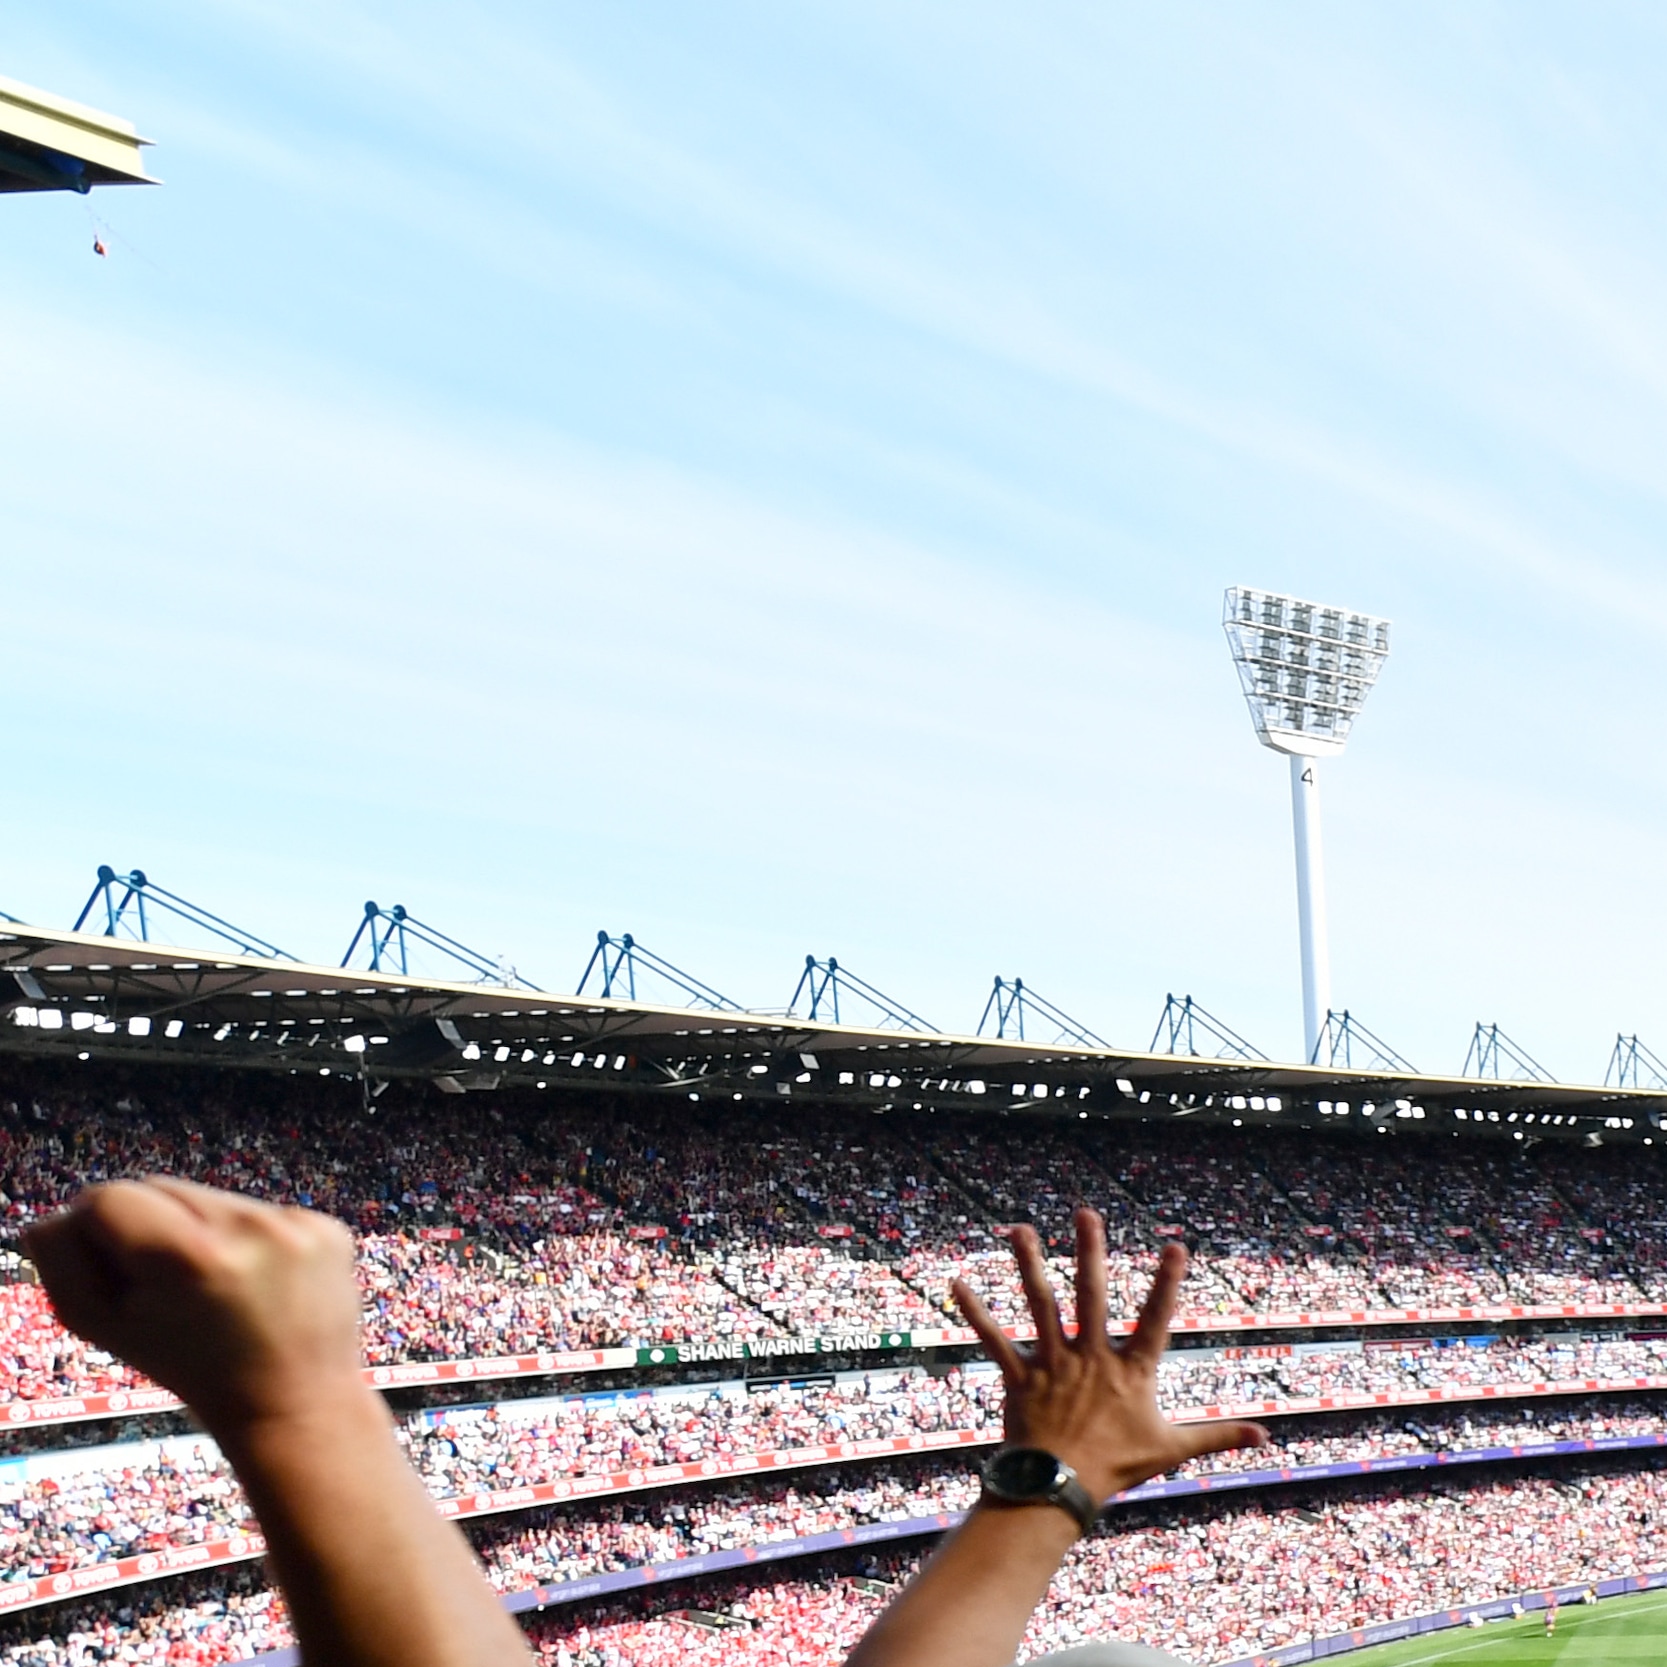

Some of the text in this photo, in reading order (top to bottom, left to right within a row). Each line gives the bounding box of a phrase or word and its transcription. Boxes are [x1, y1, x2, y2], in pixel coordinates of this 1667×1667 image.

[678, 1333, 881, 1363] SHANE WARNE STAND
[475, 1360, 519, 1374] TOYOTA
[555, 1353, 595, 1367] TOYOTA
[391, 1366, 439, 1381] TOYOTA
[33, 1400, 89, 1418] TOYOTA
[492, 1489, 535, 1505] TOYOTA
[73, 1566, 121, 1587] TOYOTA
